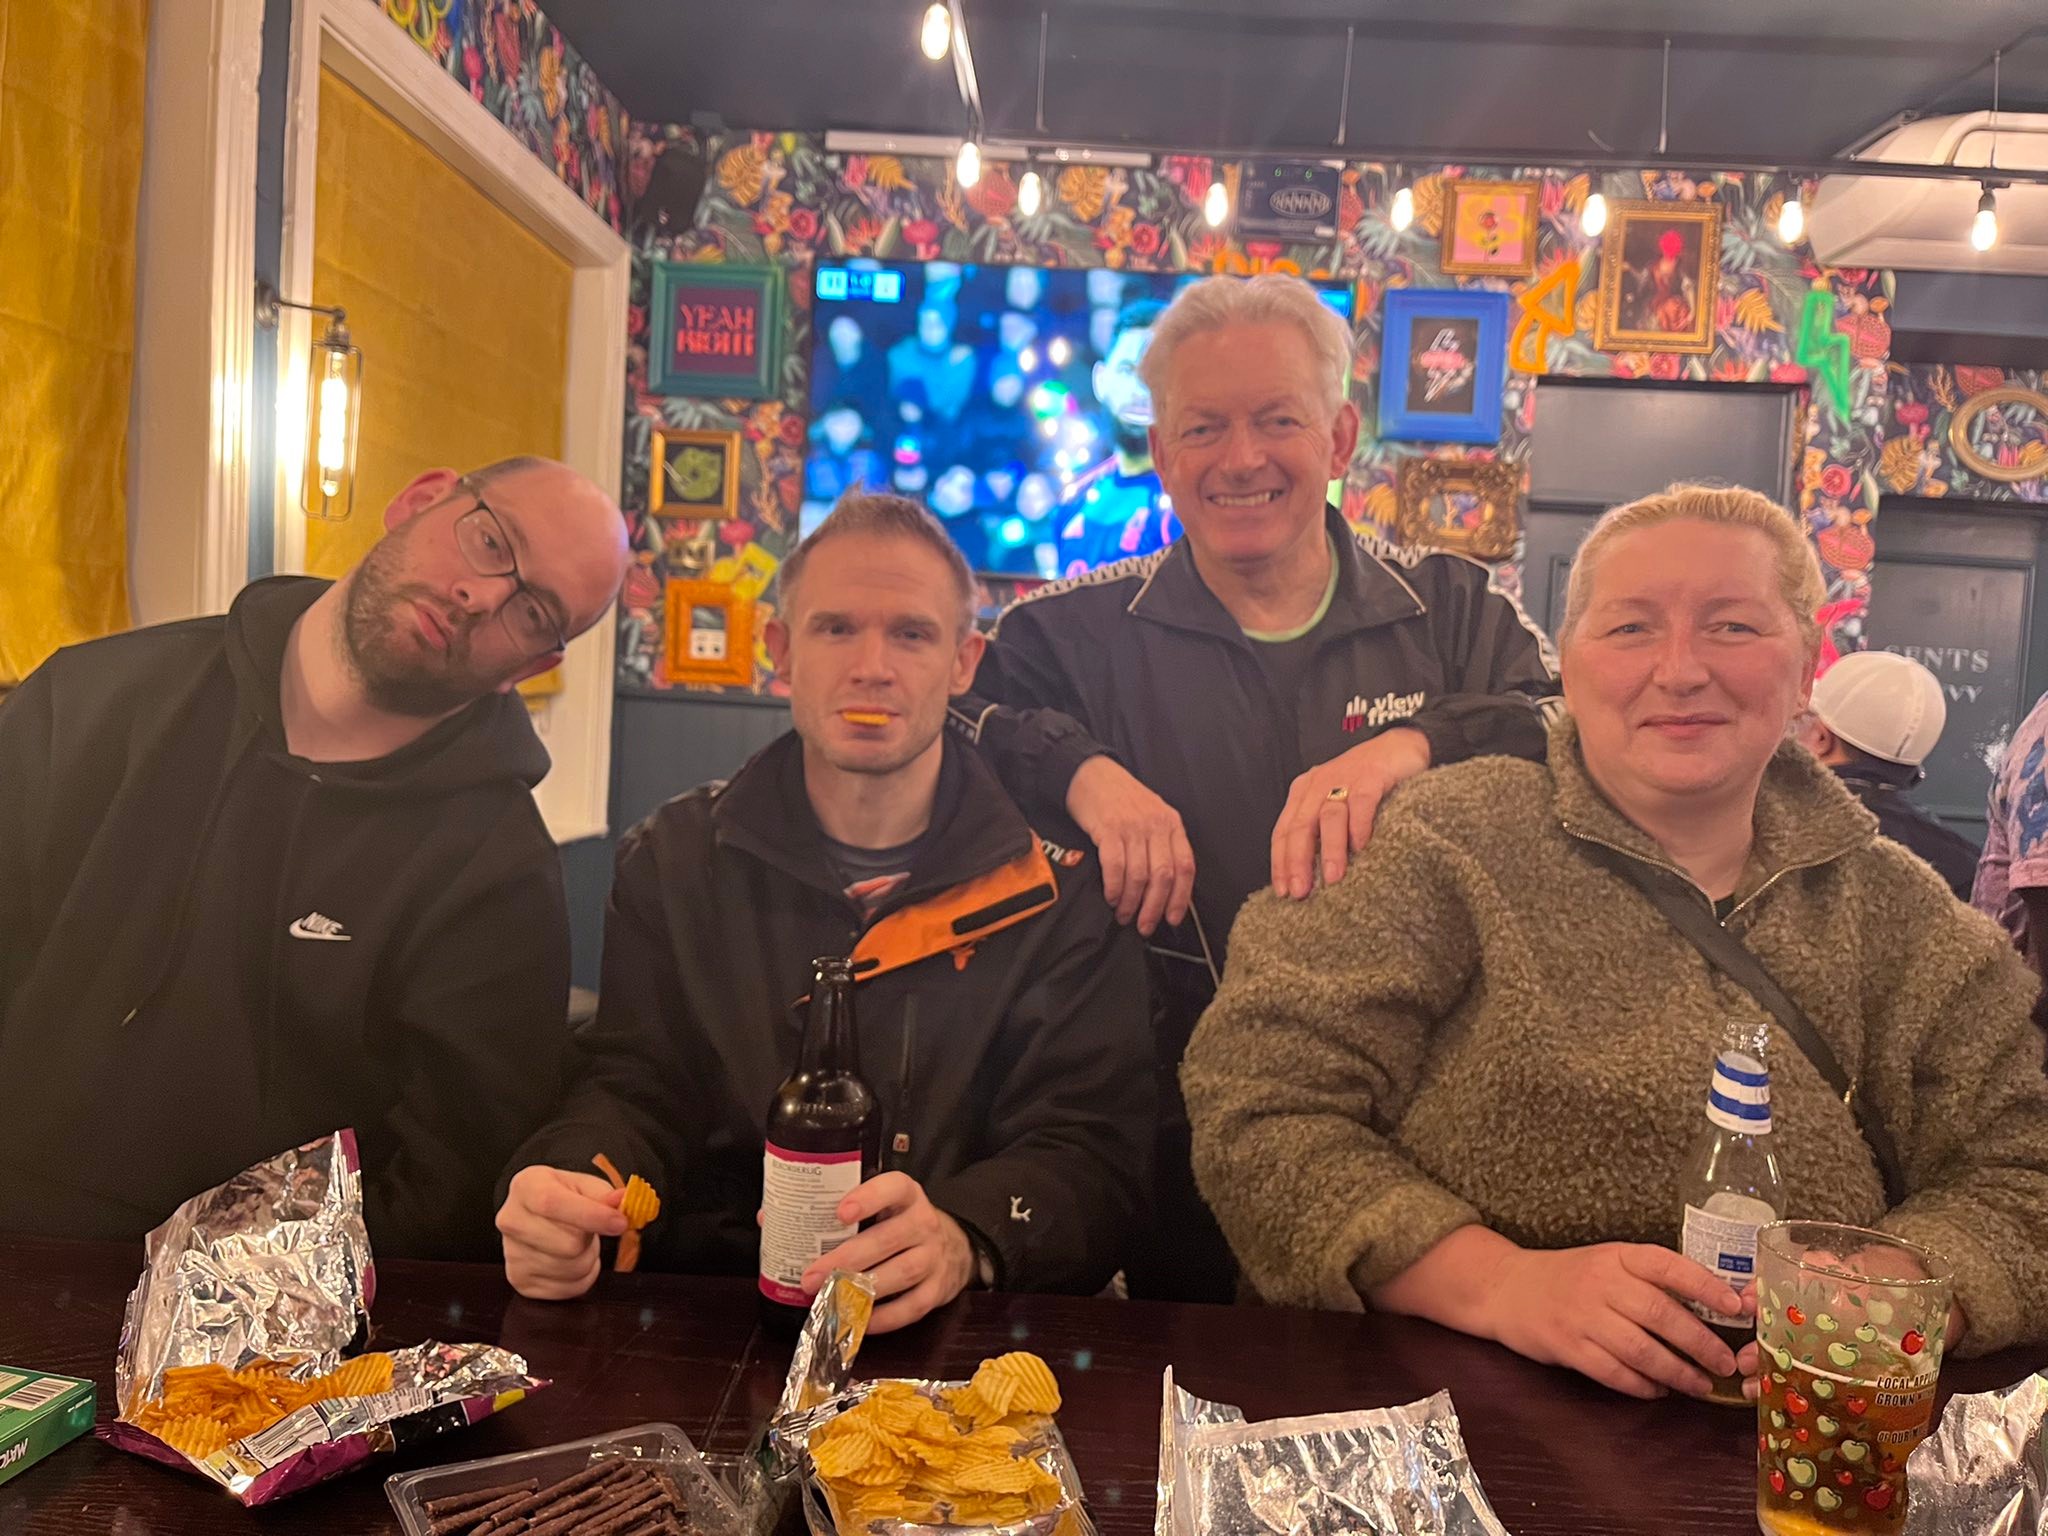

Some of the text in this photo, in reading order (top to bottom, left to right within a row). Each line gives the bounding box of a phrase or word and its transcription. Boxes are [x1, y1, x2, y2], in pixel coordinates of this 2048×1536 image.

[679, 303, 754, 330] YEAH
[1877, 1376, 1911, 1390] LOCAL
[1876, 1392, 1915, 1407] GROWN
